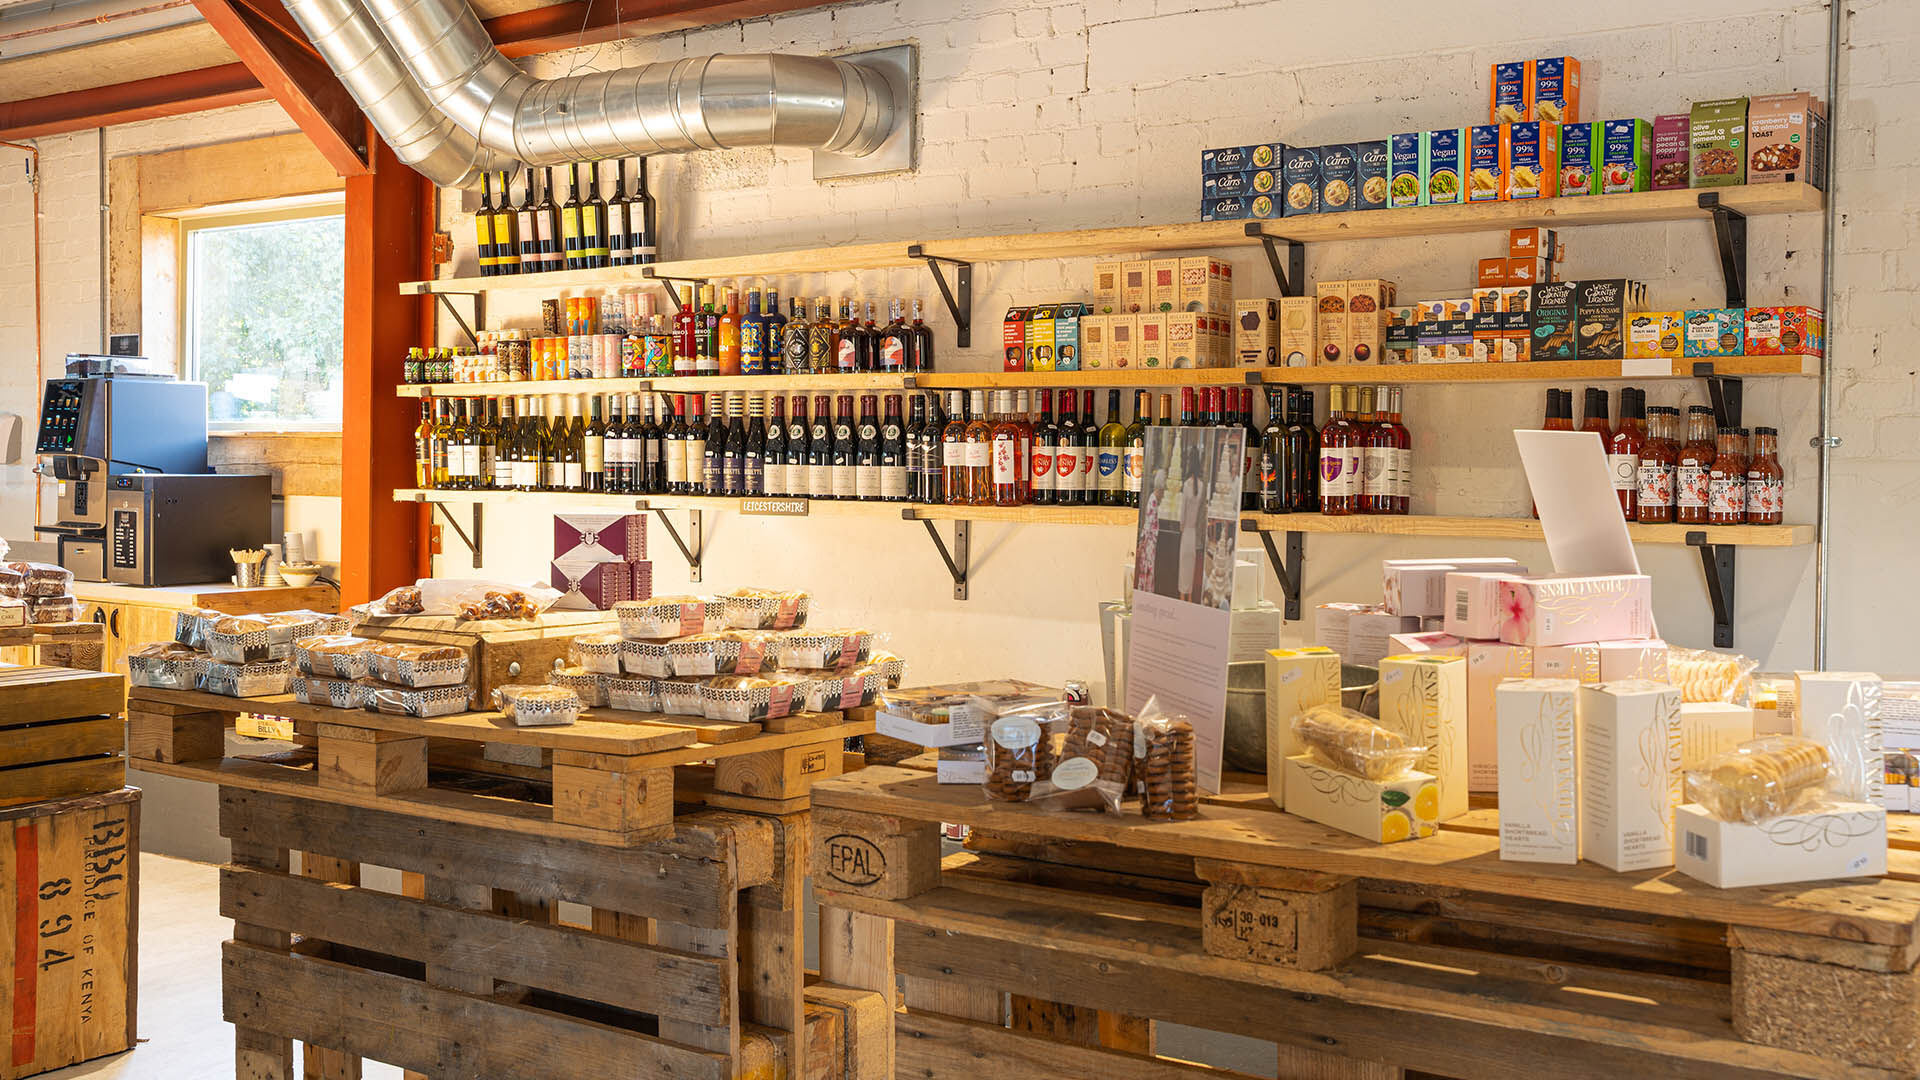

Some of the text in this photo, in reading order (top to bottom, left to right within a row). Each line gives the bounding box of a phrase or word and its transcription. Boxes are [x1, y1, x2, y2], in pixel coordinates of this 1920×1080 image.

[1500, 84, 1518, 92] 99%
[1540, 80, 1558, 88] 99%
[1752, 118, 1787, 126] cranberry
[1656, 135, 1678, 143] cherry
[1693, 135, 1725, 143] pimenton
[1515, 145, 1534, 153] 99%
[1609, 143, 1628, 151] 99%
[1656, 146, 1677, 154] poppy
[1393, 152, 1417, 161] Vegan
[1432, 148, 1456, 158] Vegan
[1545, 285, 1563, 293] WEST
[1592, 283, 1612, 291] WEST
[1538, 289, 1570, 299] COUNTRY
[1585, 287, 1618, 297] COUNTRY
[1541, 297, 1566, 305] LEGENDS
[1587, 295, 1614, 303] LEGENDS
[743, 501, 805, 513] LEICESTERSHIRE
[1425, 670, 1438, 772] IONA CAIRNS
[258, 725, 276, 734] BILLY
[1668, 695, 1682, 762] CAIRNS
[1865, 757, 1882, 799] IONA
[1505, 829, 1547, 837] SHORTBREAD
[1624, 830, 1647, 838] VANILLA
[1624, 835, 1661, 844] SHORTBREAD
[831, 844, 877, 877] EPAL
[80, 836, 97, 1024] PRODUCE OF KENYA
